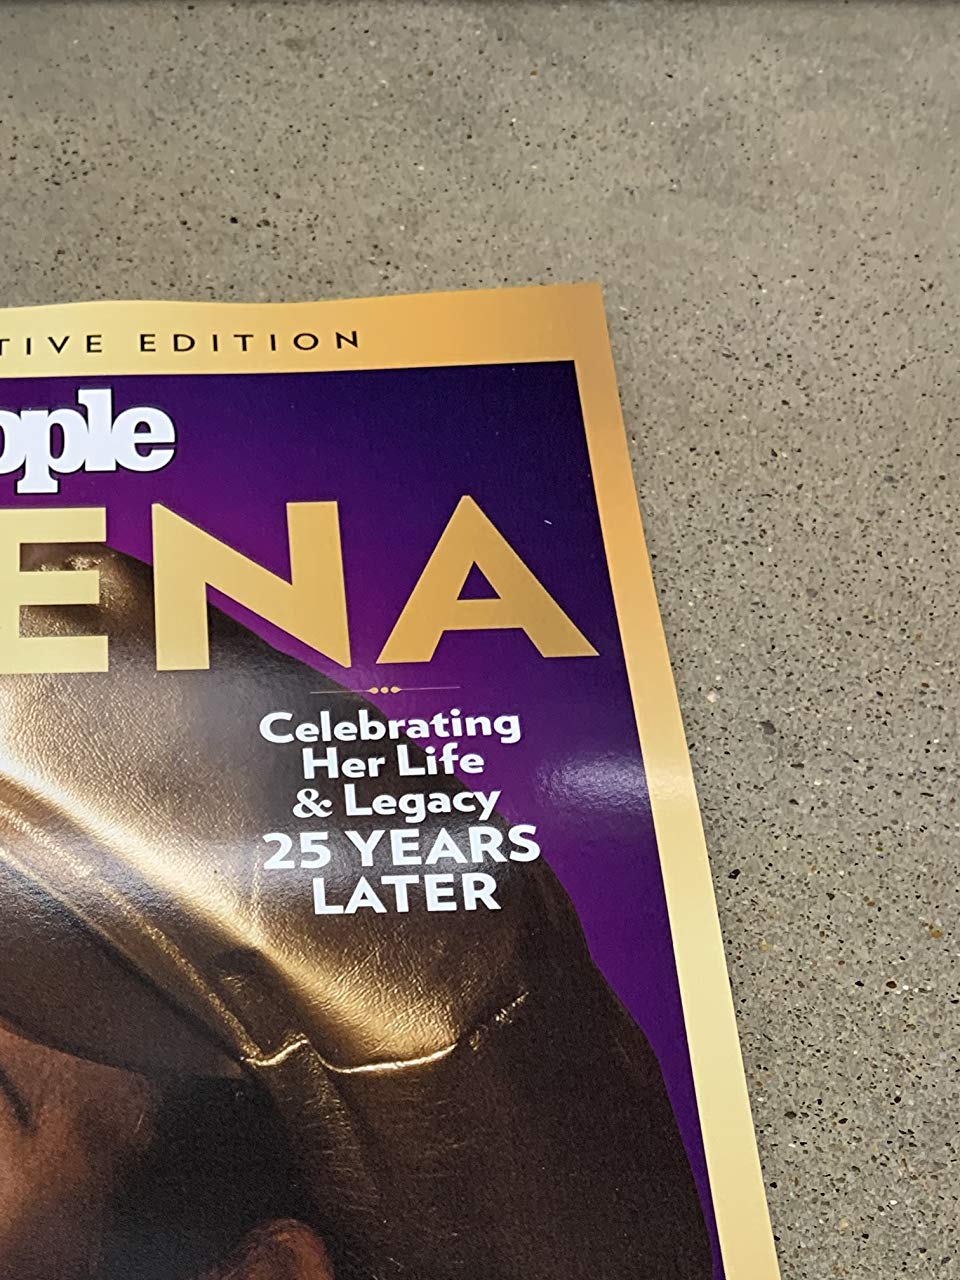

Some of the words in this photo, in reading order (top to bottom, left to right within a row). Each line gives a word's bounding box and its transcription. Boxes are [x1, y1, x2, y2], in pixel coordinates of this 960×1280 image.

[140, 330, 360, 354] EDITION
[259, 709, 521, 744] Celebrating
[302, 747, 385, 779] Her
[397, 743, 485, 776] Life
[293, 788, 332, 818] &
[344, 784, 501, 823] Legacy
[262, 832, 331, 870] 25
[345, 825, 541, 867] YEARS
[313, 873, 501, 915] LATER
